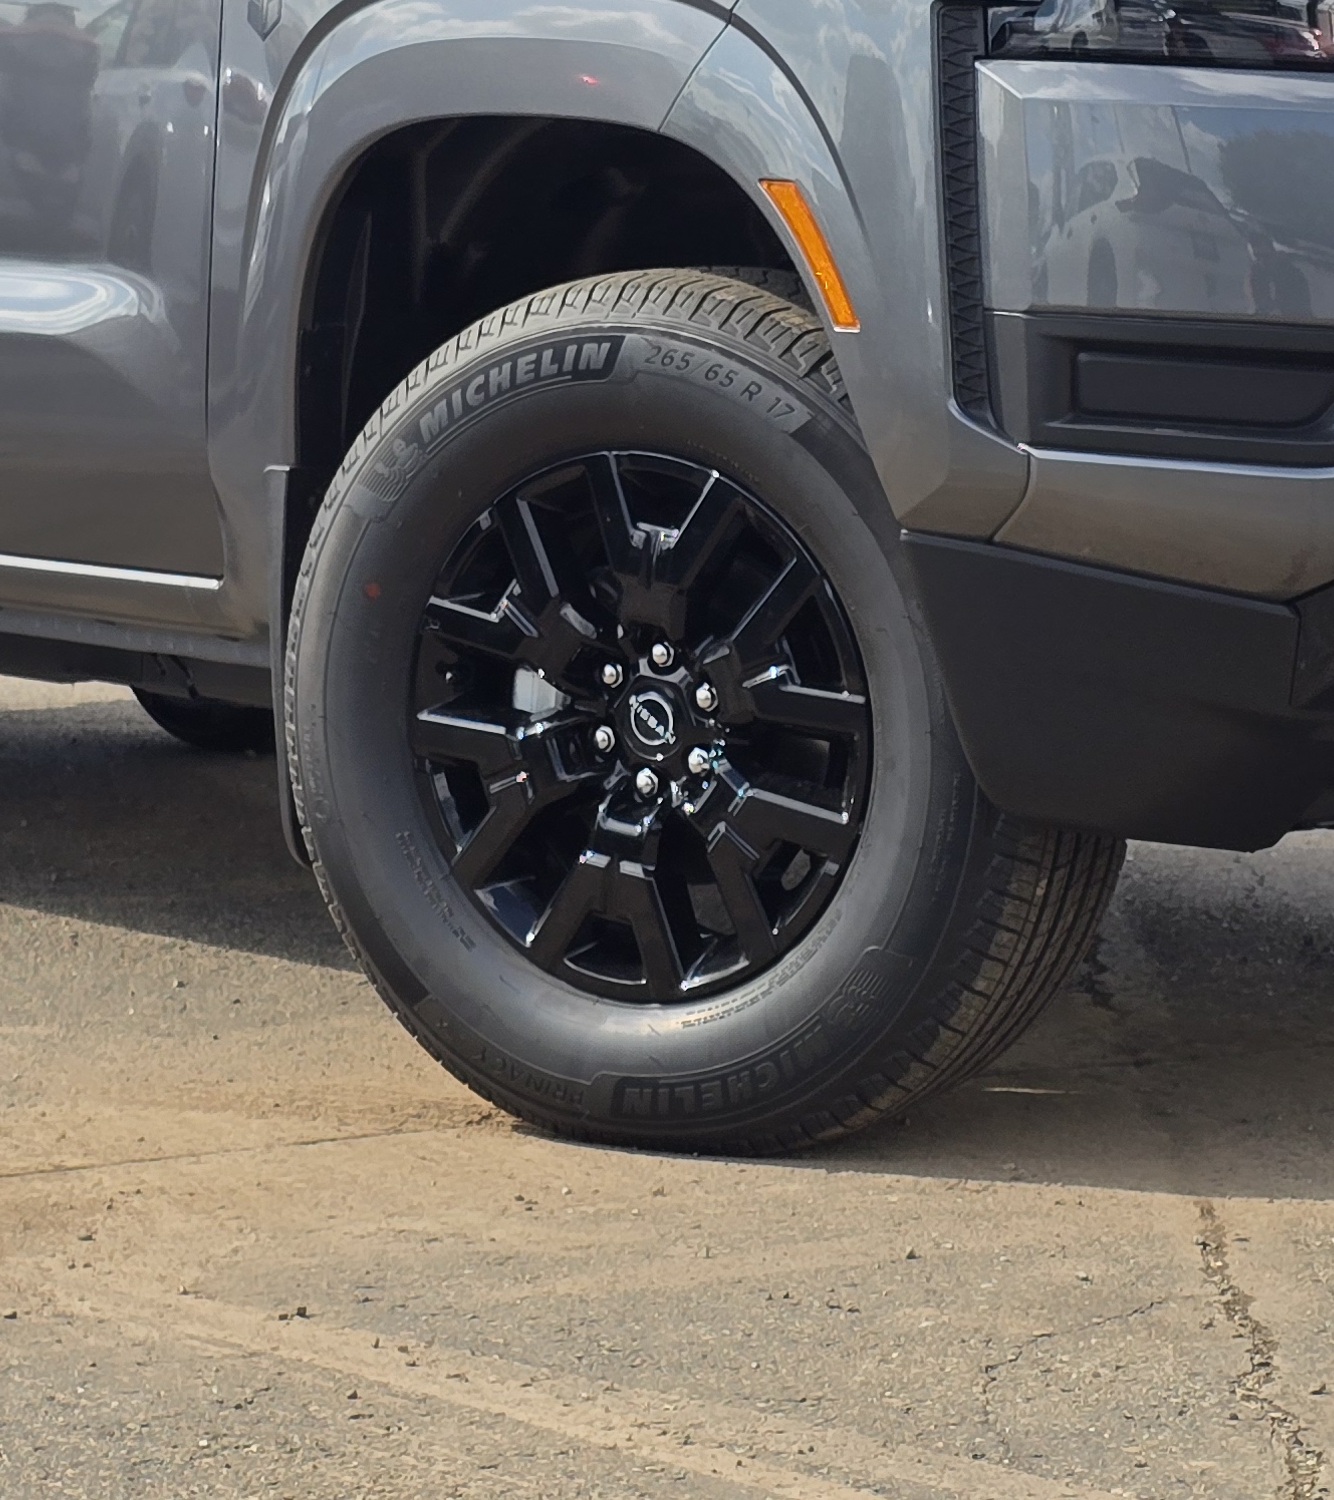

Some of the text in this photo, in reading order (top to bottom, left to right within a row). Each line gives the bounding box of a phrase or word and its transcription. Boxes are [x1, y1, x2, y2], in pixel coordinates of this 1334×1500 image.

[418, 341, 611, 444] MICHELIN
[644, 344, 797, 421] 265/65 R 17
[628, 695, 677, 745] NISSAN
